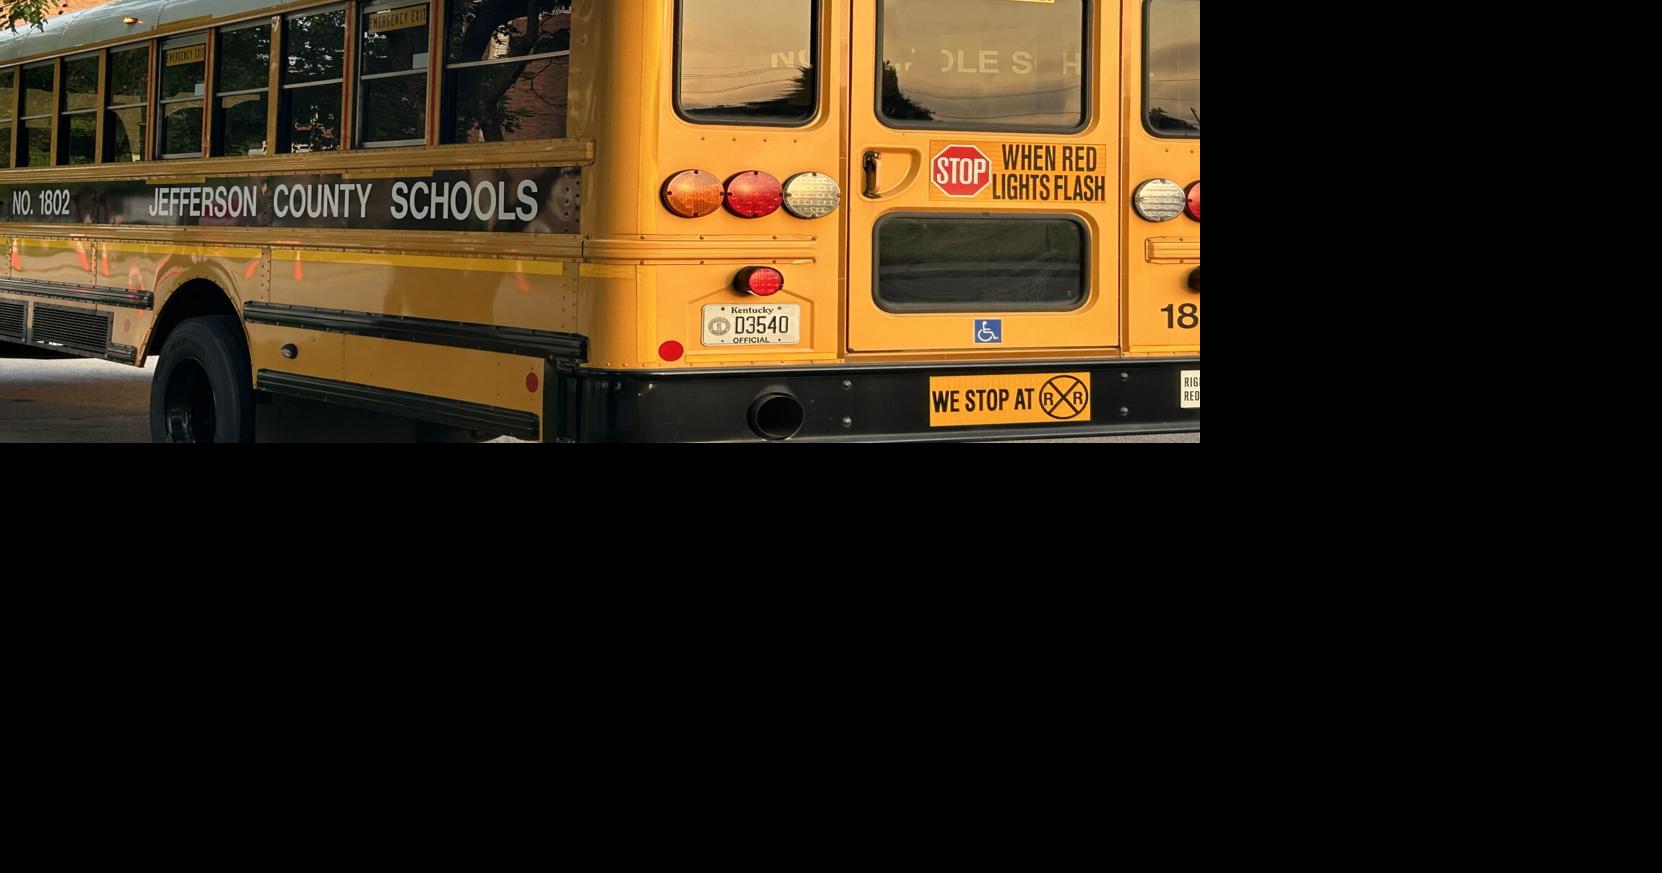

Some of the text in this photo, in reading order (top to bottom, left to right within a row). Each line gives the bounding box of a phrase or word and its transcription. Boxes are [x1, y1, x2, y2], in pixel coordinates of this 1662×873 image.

[936, 144, 1097, 185] STOP WHEN RED
[992, 174, 1106, 201] LIGHTS FLASH
[12, 189, 71, 216] NO. 1802
[149, 179, 539, 222] JEFFERSON COUNTY SCHOOLS
[731, 306, 774, 315] Kentucky
[1160, 303, 1200, 329] 18
[735, 315, 789, 334] D3540
[732, 336, 770, 344] OFFICIAL
[1184, 376, 1201, 388] RIG
[932, 390, 960, 413] WE
[965, 388, 1010, 412] STOP
[1014, 388, 1035, 410] AT
